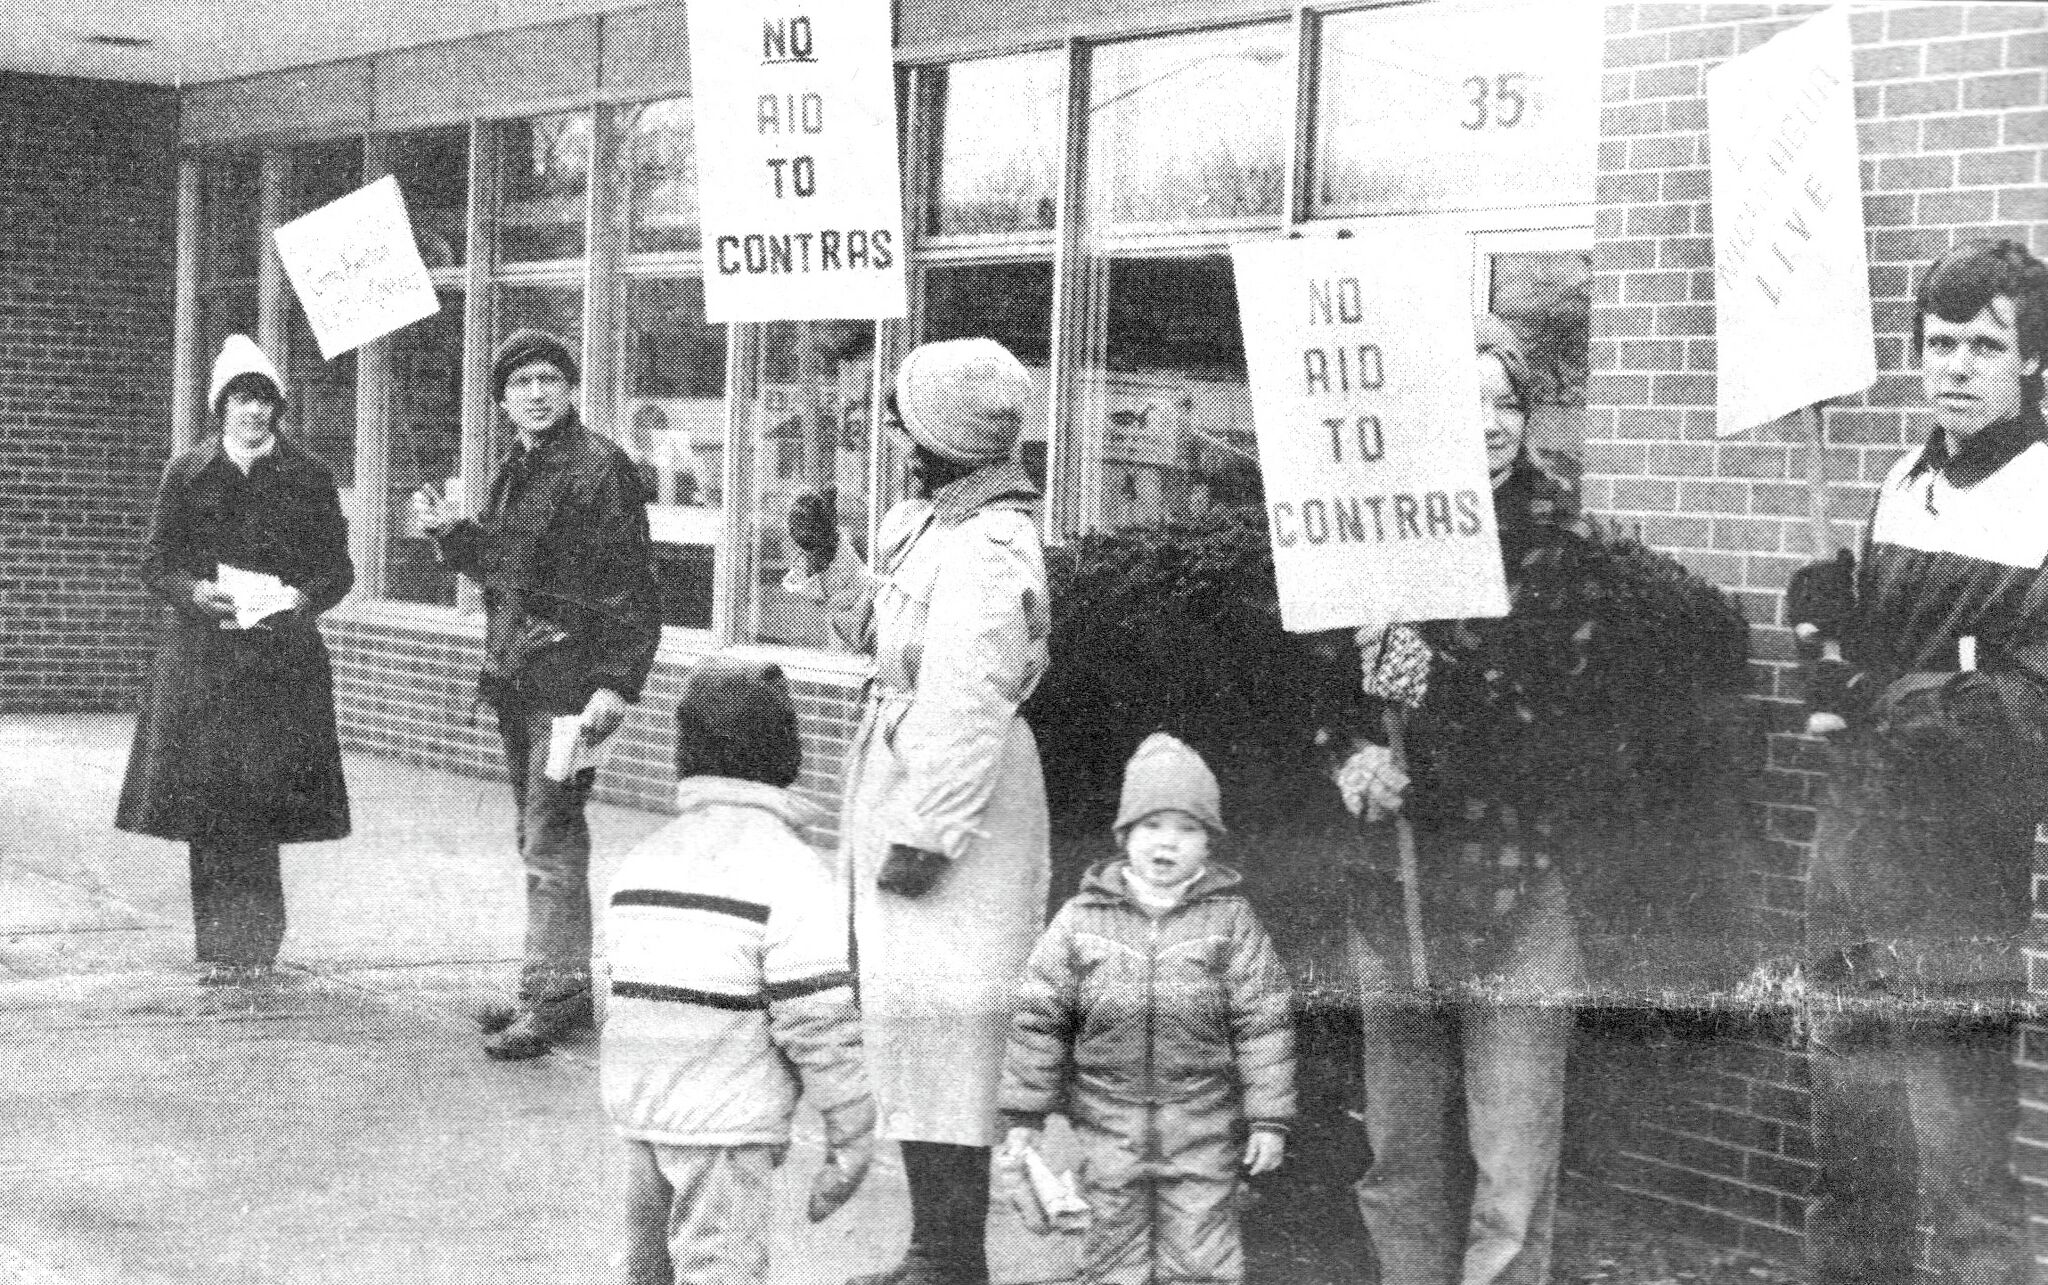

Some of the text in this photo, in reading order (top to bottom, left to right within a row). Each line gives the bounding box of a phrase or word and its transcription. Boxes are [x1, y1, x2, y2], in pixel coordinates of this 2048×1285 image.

[762, 15, 813, 57] NO
[757, 91, 822, 134] AID
[766, 154, 816, 198] TO
[716, 229, 893, 275] CONTRAS
[1755, 173, 1833, 308] LIVE
[1309, 277, 1363, 326] NO
[1303, 344, 1384, 395] AID
[1322, 414, 1385, 463] TO
[1273, 490, 1482, 547] CONTRAS
